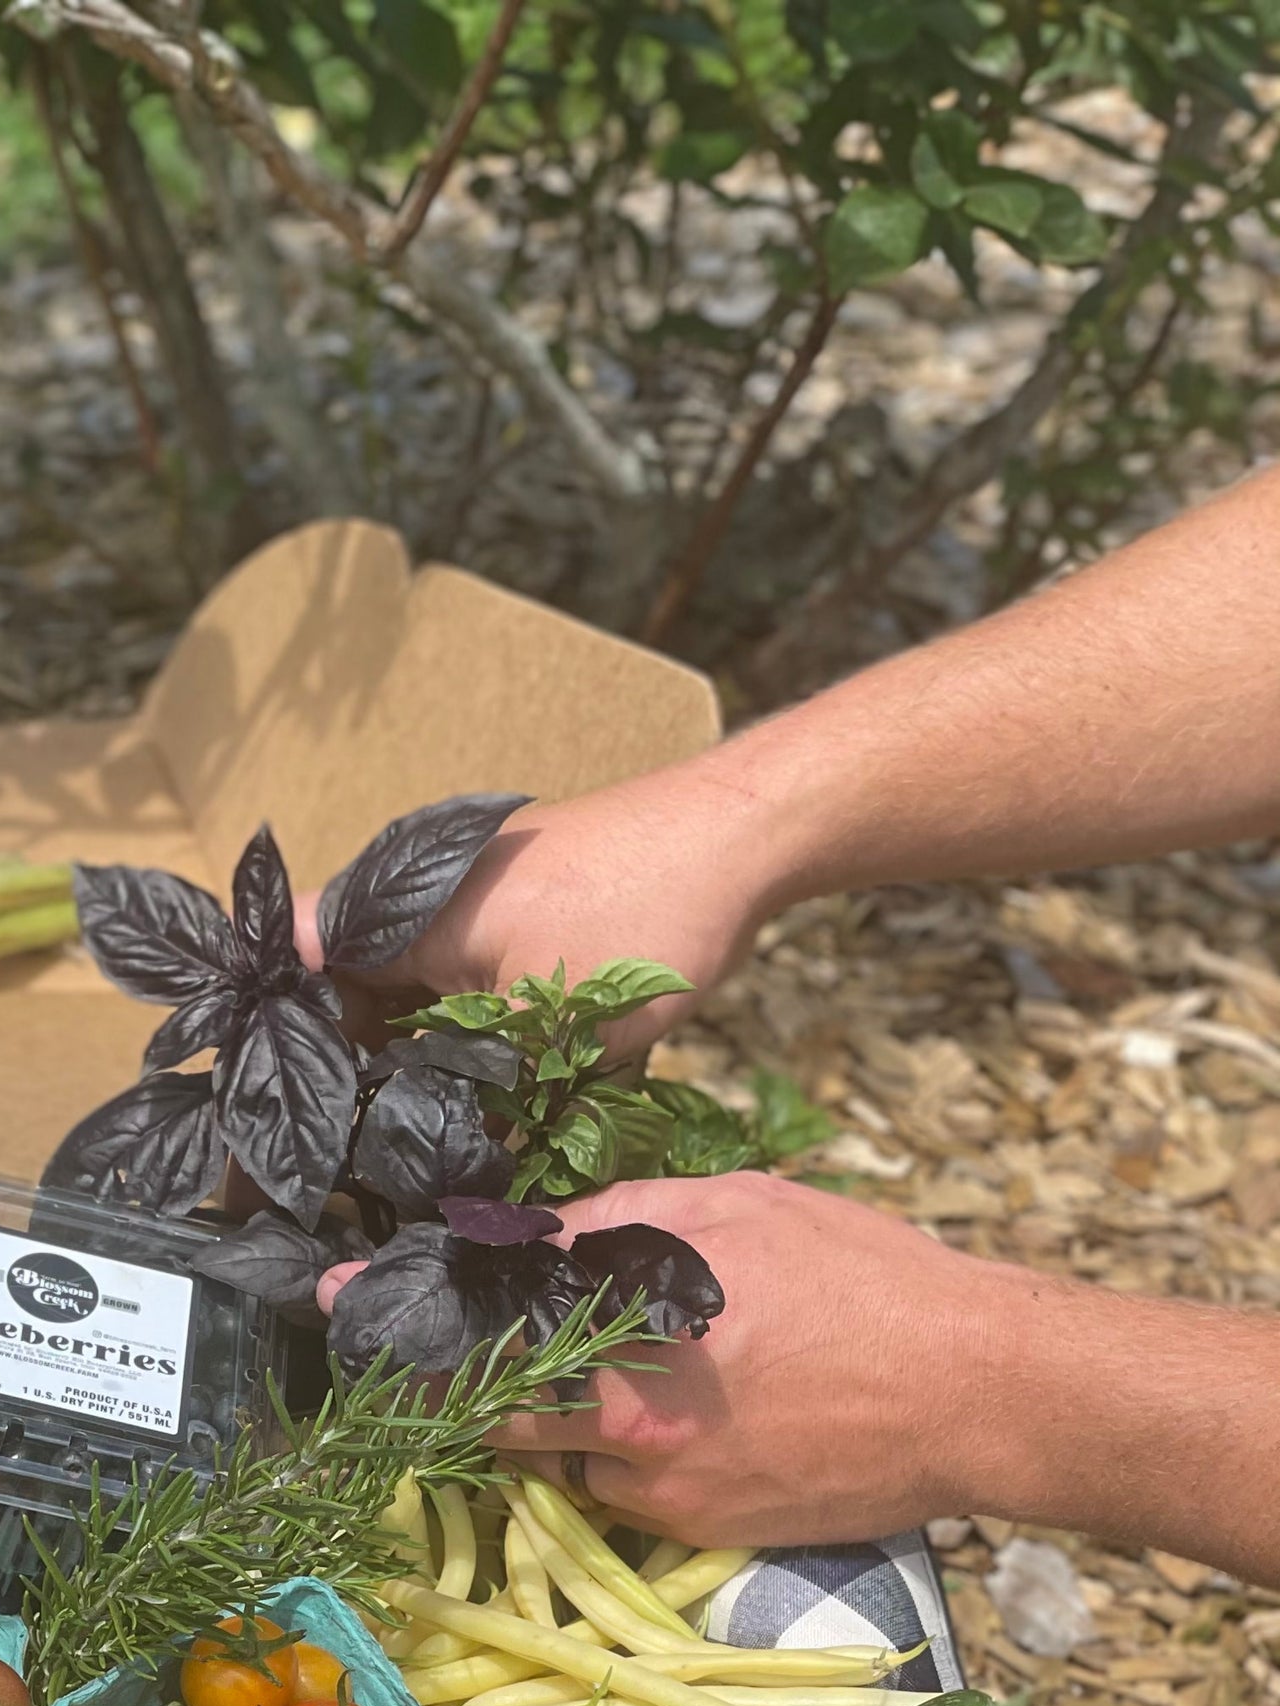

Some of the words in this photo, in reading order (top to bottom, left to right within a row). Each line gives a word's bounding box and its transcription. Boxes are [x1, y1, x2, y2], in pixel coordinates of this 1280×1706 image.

[11, 1267, 94, 1299] Blossom
[33, 1288, 89, 1316] Creek
[103, 1297, 138, 1313] GROWN
[34, 1388, 56, 1401] U.S.
[61, 1395, 85, 1407] DRY
[88, 1402, 115, 1415] PINT
[128, 1411, 149, 1423] 551
[154, 1417, 171, 1428] ML
[65, 1386, 119, 1405] PRODUCT
[123, 1400, 138, 1410] OF
[142, 1404, 172, 1418] U.S.A
